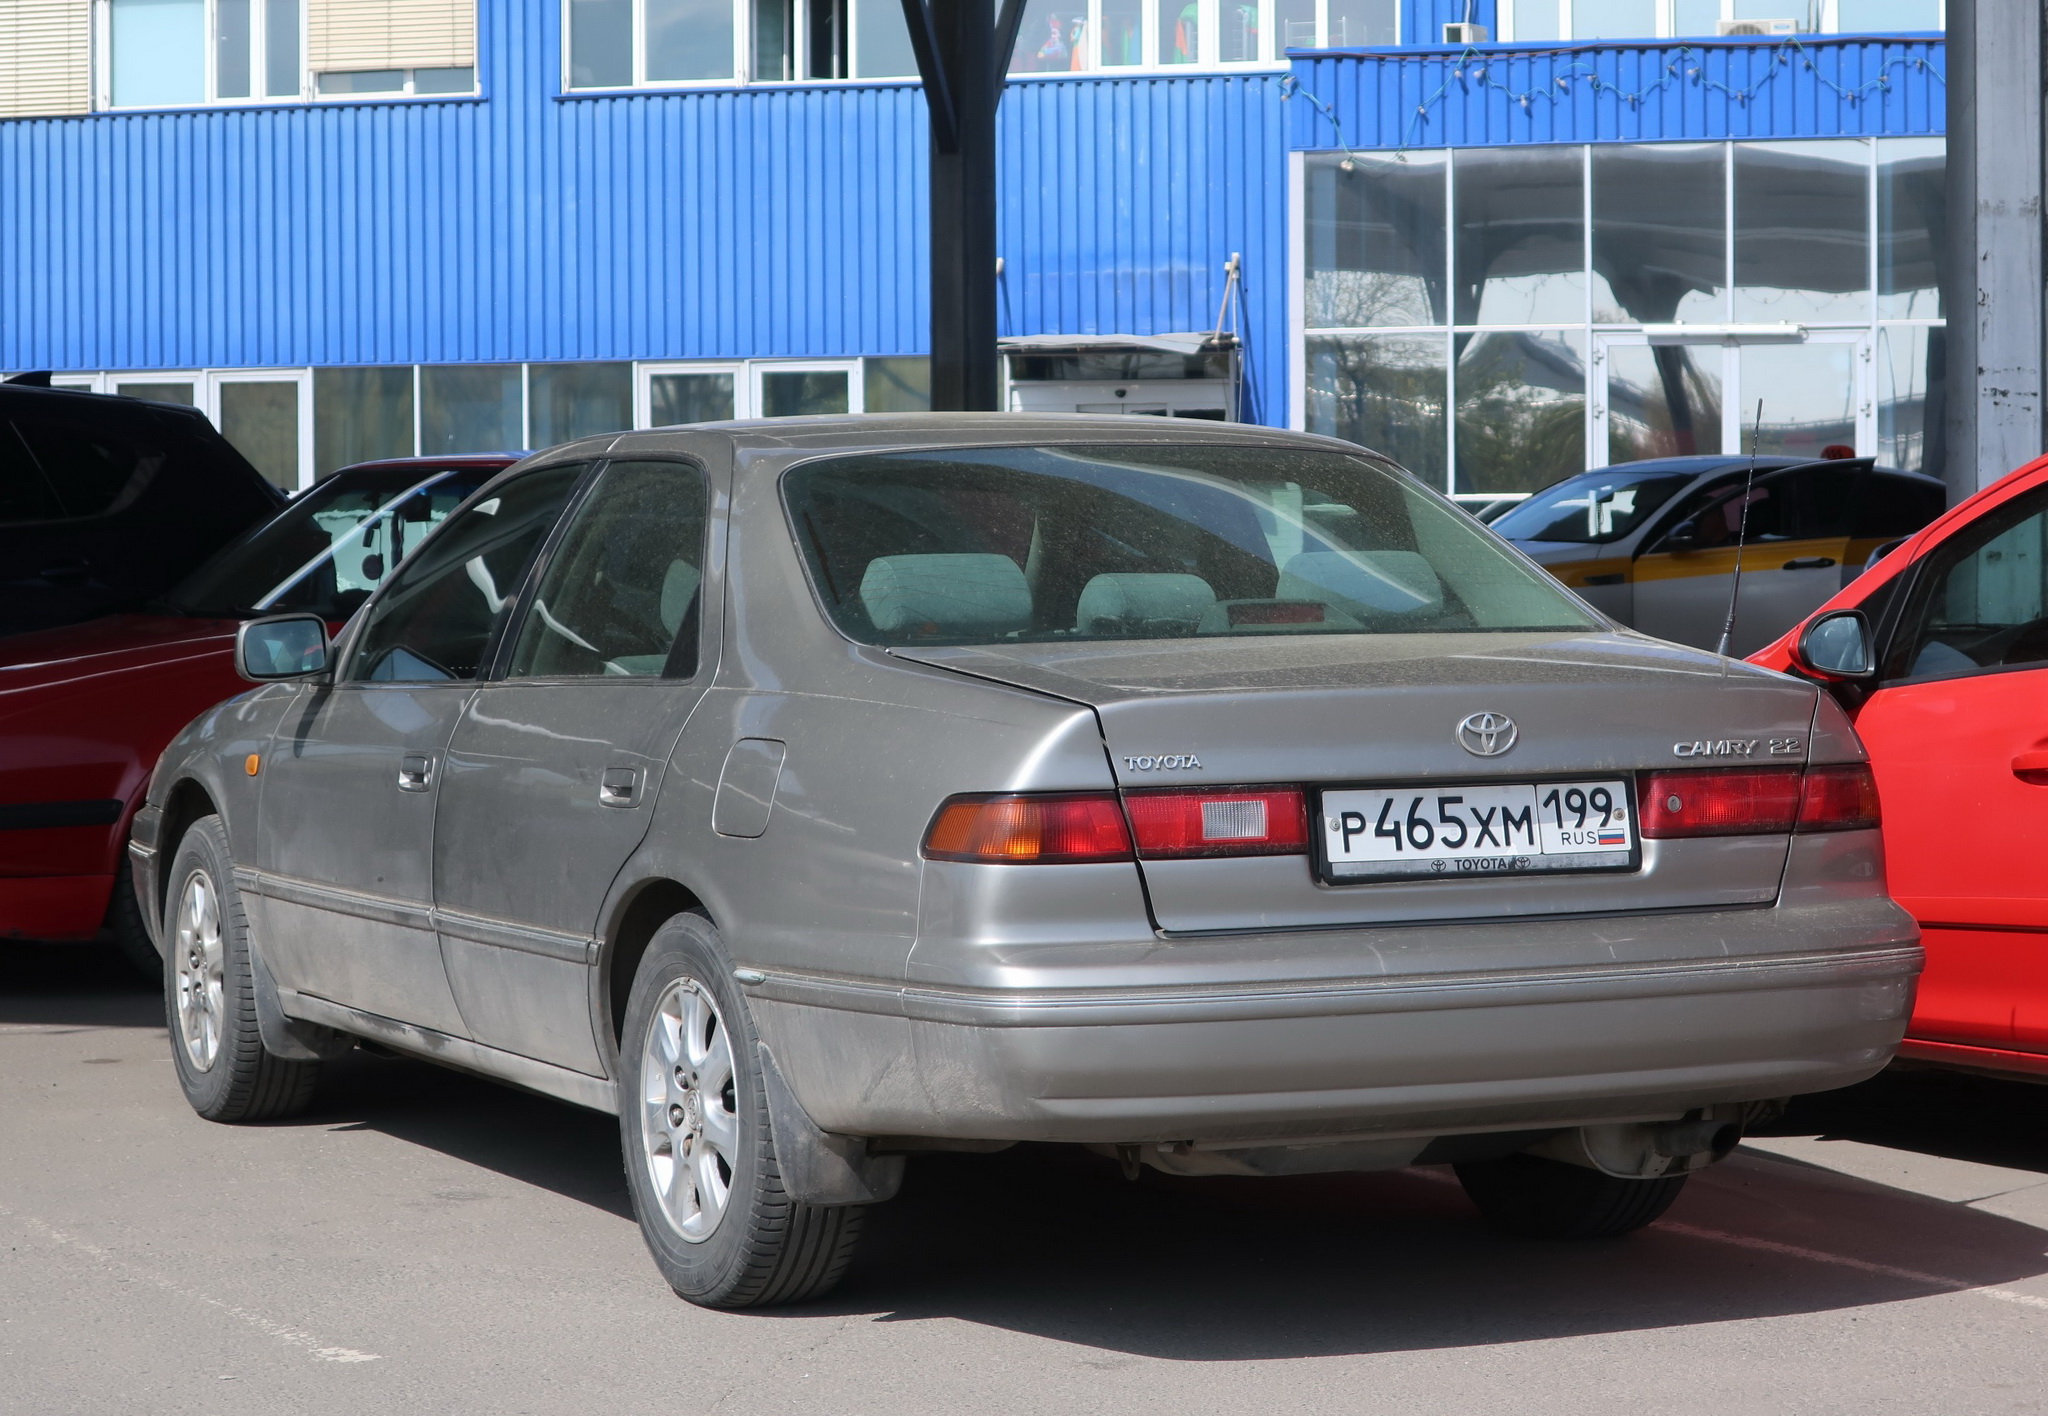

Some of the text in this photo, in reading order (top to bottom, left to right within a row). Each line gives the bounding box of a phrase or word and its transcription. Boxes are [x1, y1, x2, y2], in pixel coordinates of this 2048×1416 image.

[1673, 739, 1759, 758] CAMRY
[1124, 754, 1201, 771] TOYOTA
[1543, 787, 1613, 829] 199
[1561, 831, 1597, 846] RUS
[1454, 857, 1507, 871] TOYOTA
